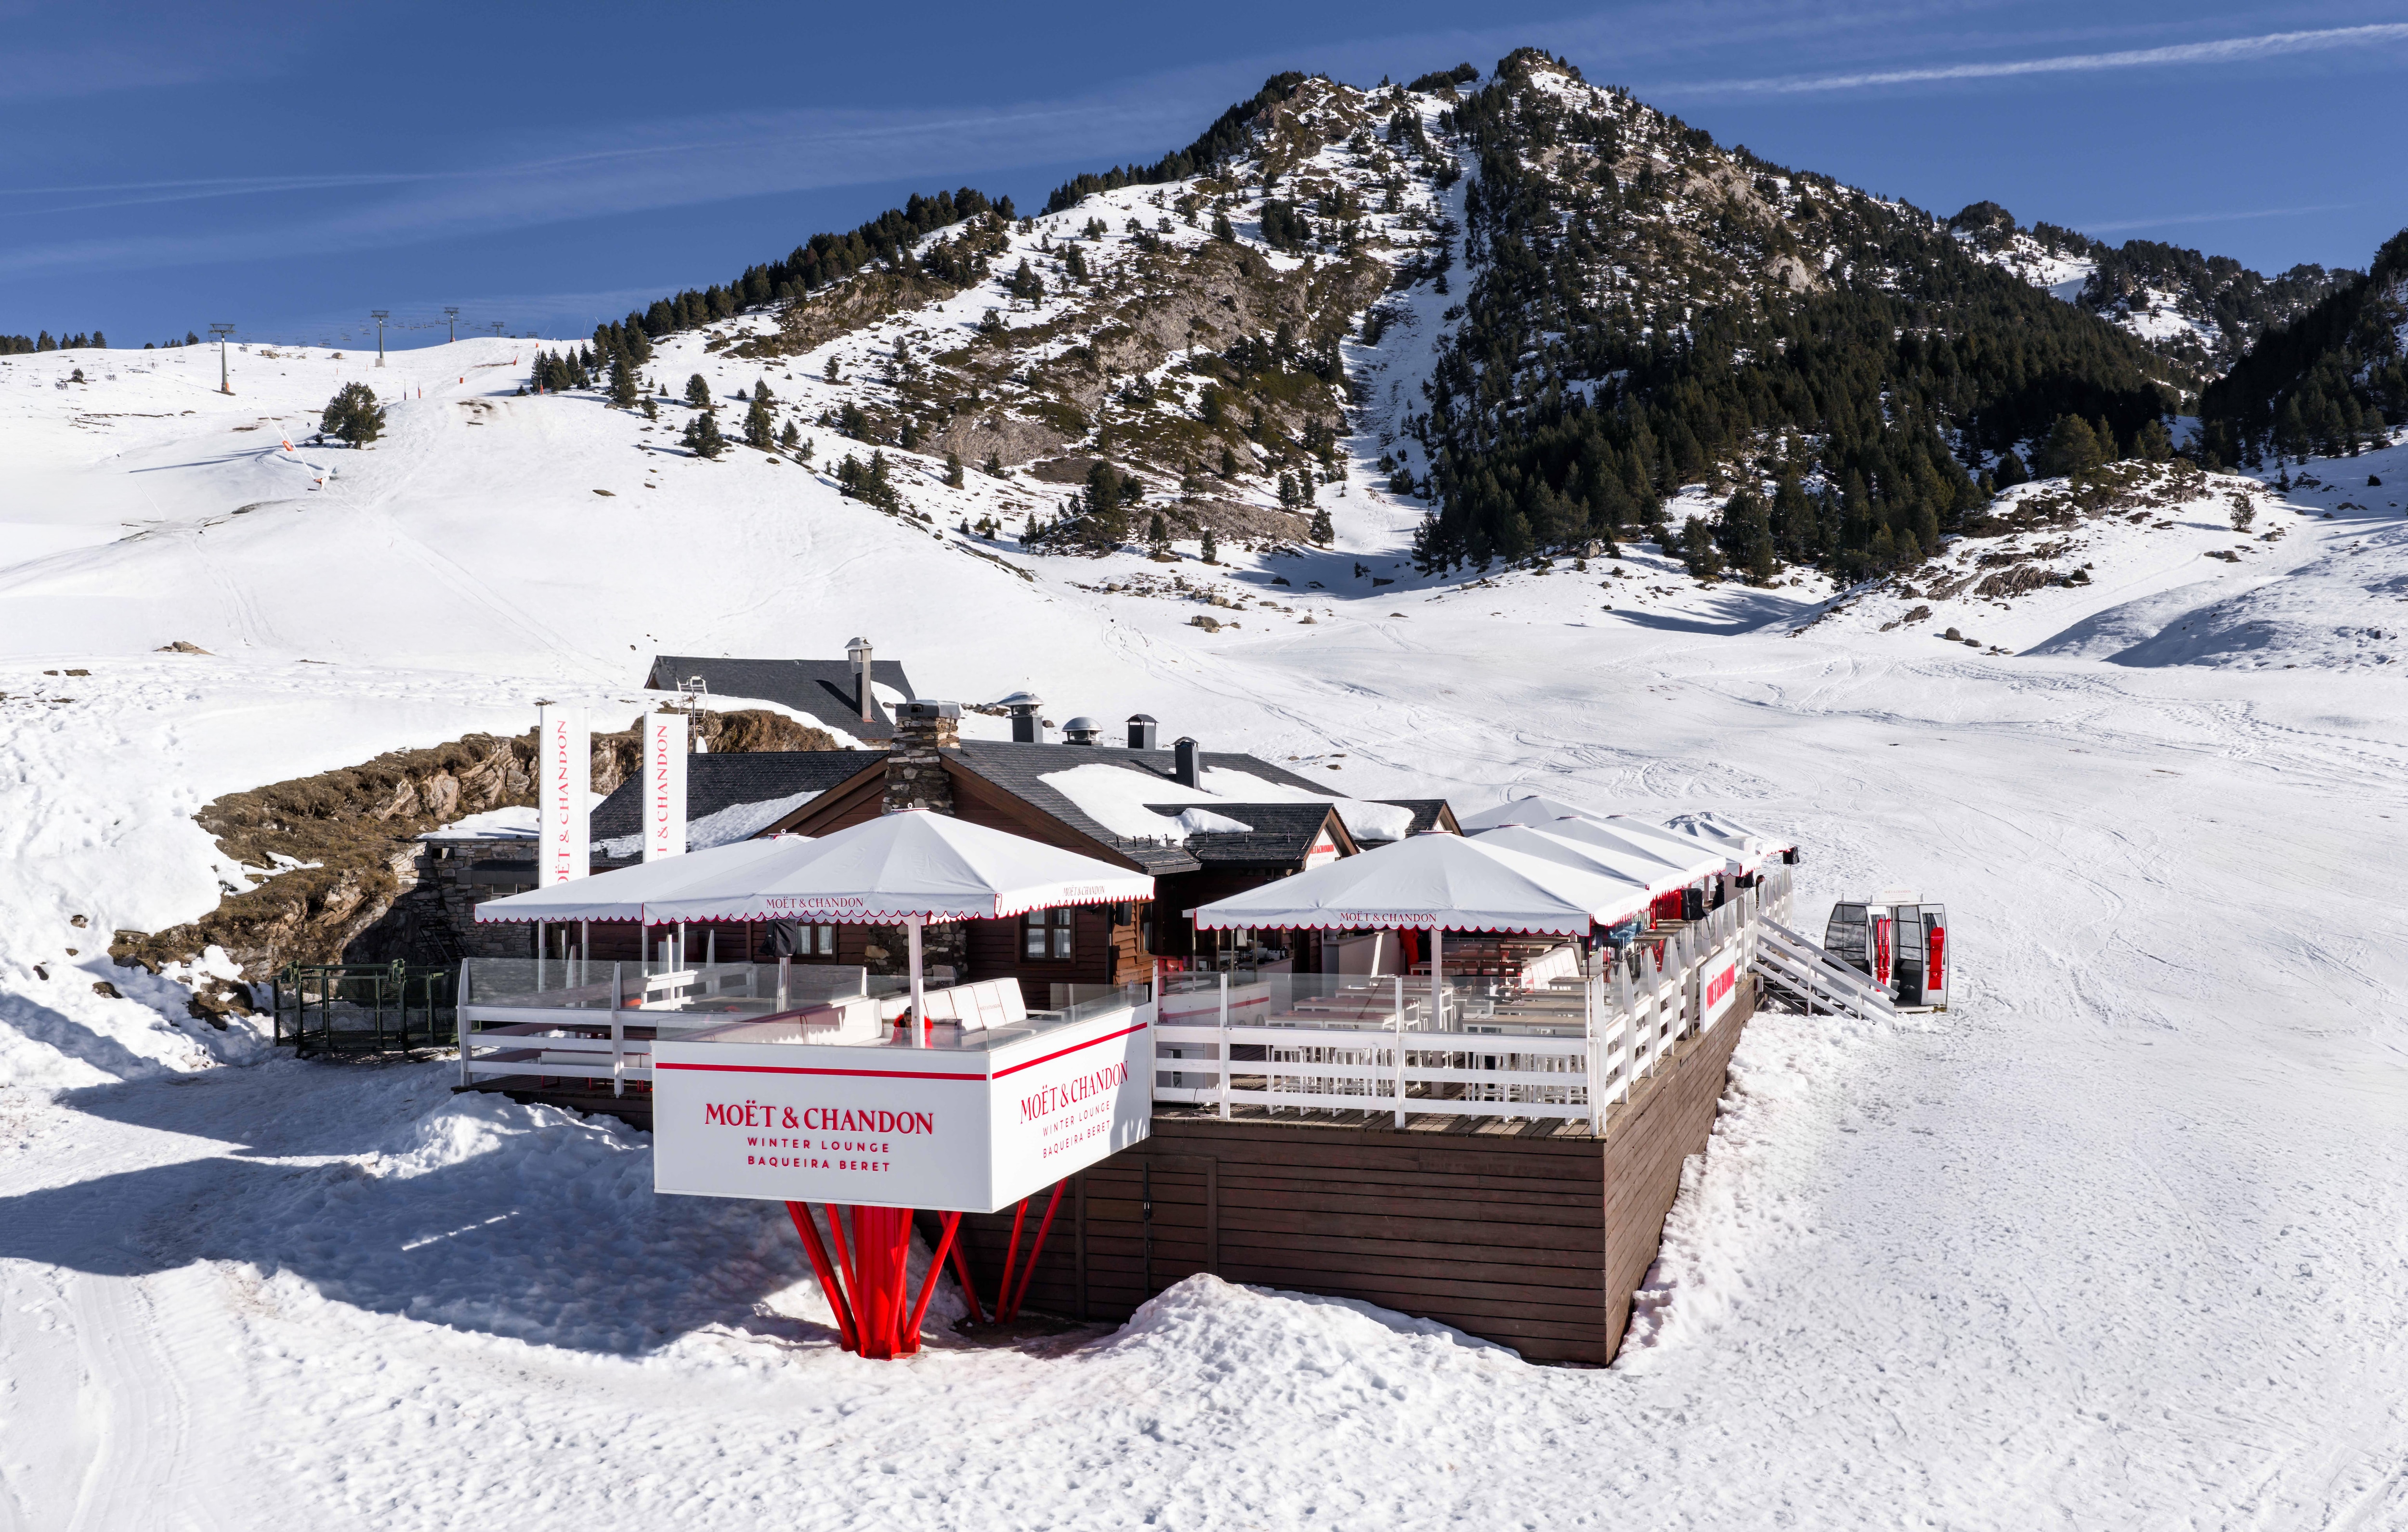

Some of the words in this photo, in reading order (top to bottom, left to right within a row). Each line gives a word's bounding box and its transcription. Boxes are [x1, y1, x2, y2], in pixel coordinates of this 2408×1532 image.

[557, 720, 569, 825] CHANDON
[657, 725, 668, 822] CHANDON
[559, 829, 569, 843] &
[657, 826, 668, 839] &
[555, 848, 570, 885] OËT
[767, 896, 797, 909] MOËT
[799, 898, 807, 908] &
[808, 897, 864, 908] CHANDON
[1062, 884, 1077, 896] MOËT
[1077, 886, 1081, 896] &
[1082, 885, 1105, 896] CHANDON
[1340, 911, 1371, 922] MOËT
[1373, 913, 1380, 922] &
[1382, 913, 1437, 922] CHANDON
[1021, 1084, 1058, 1124] MOËT
[1060, 1083, 1069, 1107] &
[1071, 1060, 1128, 1103] CHANDON
[705, 1100, 776, 1128] MOËT
[782, 1106, 799, 1129] &
[804, 1108, 934, 1135] CHANDON
[1043, 1116, 1074, 1137] WINTER
[1079, 1101, 1110, 1121] LOUNGE
[747, 1137, 811, 1149] WINTER
[822, 1141, 889, 1153] LOUNGE
[1043, 1132, 1083, 1158] BAQUEIRA
[1087, 1120, 1110, 1138] BERET
[748, 1155, 829, 1168] BAQUEIRA
[839, 1160, 890, 1172] BERET
